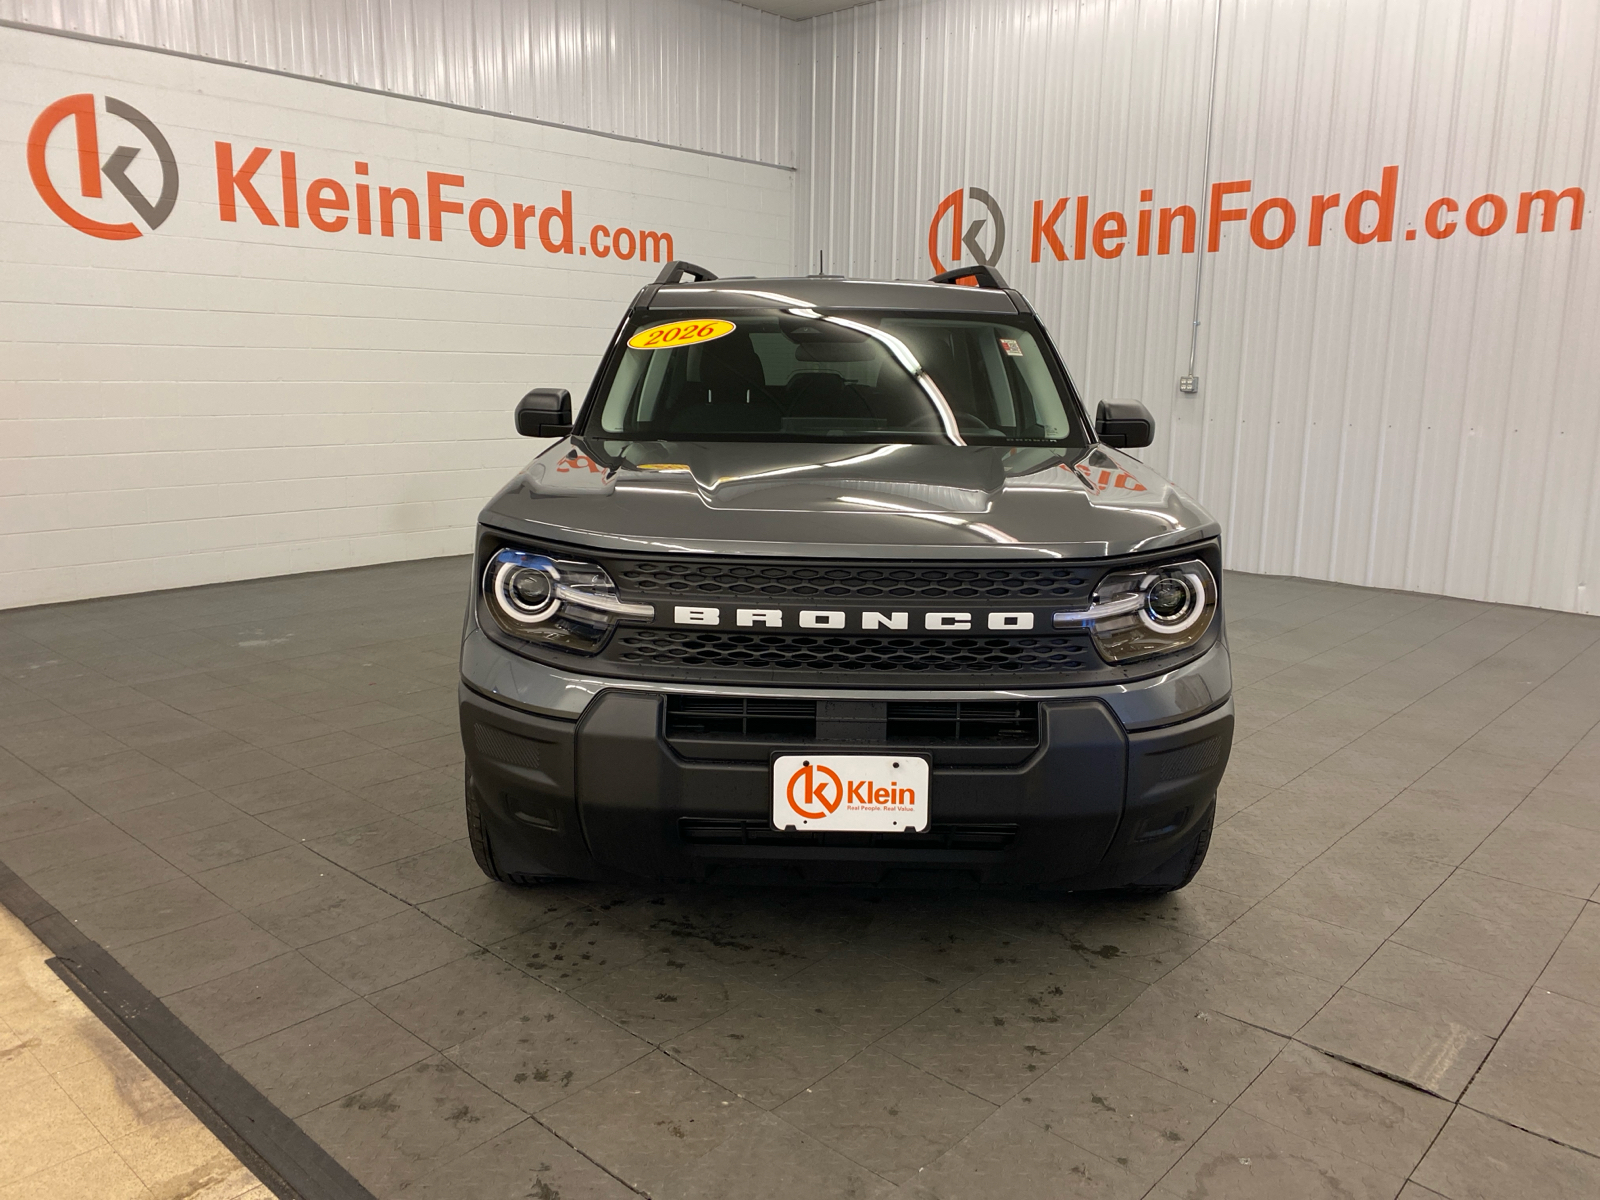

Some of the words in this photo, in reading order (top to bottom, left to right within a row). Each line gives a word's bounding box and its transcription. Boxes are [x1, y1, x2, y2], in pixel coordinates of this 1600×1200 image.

[214, 141, 674, 263] KleinFord.com
[1030, 165, 1585, 263] KleinFord.com
[644, 322, 718, 347] 2026
[674, 605, 1035, 630] BRONCO
[847, 780, 915, 805] Klein
